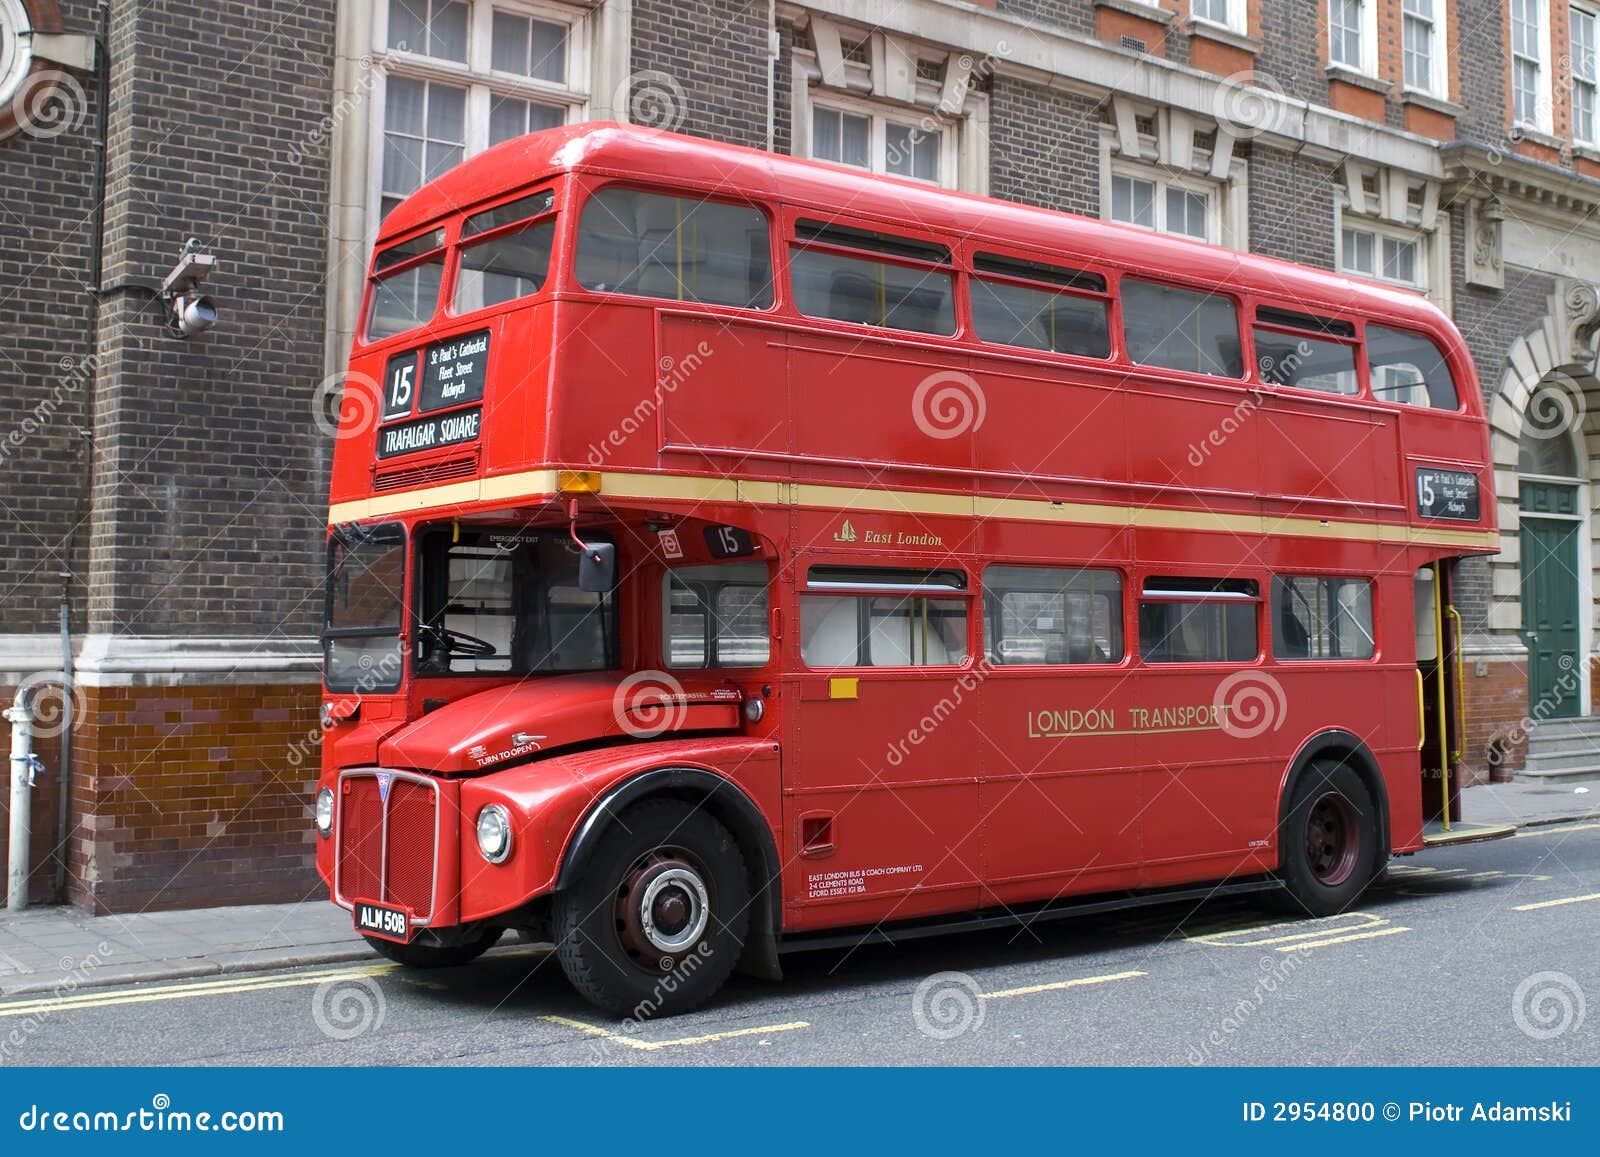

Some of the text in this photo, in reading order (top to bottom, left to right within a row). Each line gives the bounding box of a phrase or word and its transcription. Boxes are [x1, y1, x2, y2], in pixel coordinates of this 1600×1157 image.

[460, 337, 487, 357] Cathedral
[439, 361, 473, 380] Fleet Street
[391, 365, 414, 407] 15
[441, 379, 465, 399] Aldwych
[385, 413, 479, 452] TRAFALGAR SQUARE
[1418, 475, 1435, 506] 15
[490, 534, 524, 543] EMERGENCY
[718, 527, 739, 553] 15
[864, 530, 942, 545] East London
[1028, 704, 1233, 738] LONDON TRANSPORT
[477, 755, 499, 766] TURN
[499, 750, 511, 760] TO
[511, 744, 532, 756] OPEN
[809, 874, 823, 882] EAST
[824, 872, 848, 880] LONDON
[850, 870, 860, 878] BUS
[867, 867, 885, 876] COACH
[886, 866, 912, 874] COMPANY
[819, 880, 848, 888] CLEMENTS
[830, 887, 847, 895] ESSEX
[361, 906, 406, 934] ALM 50B
